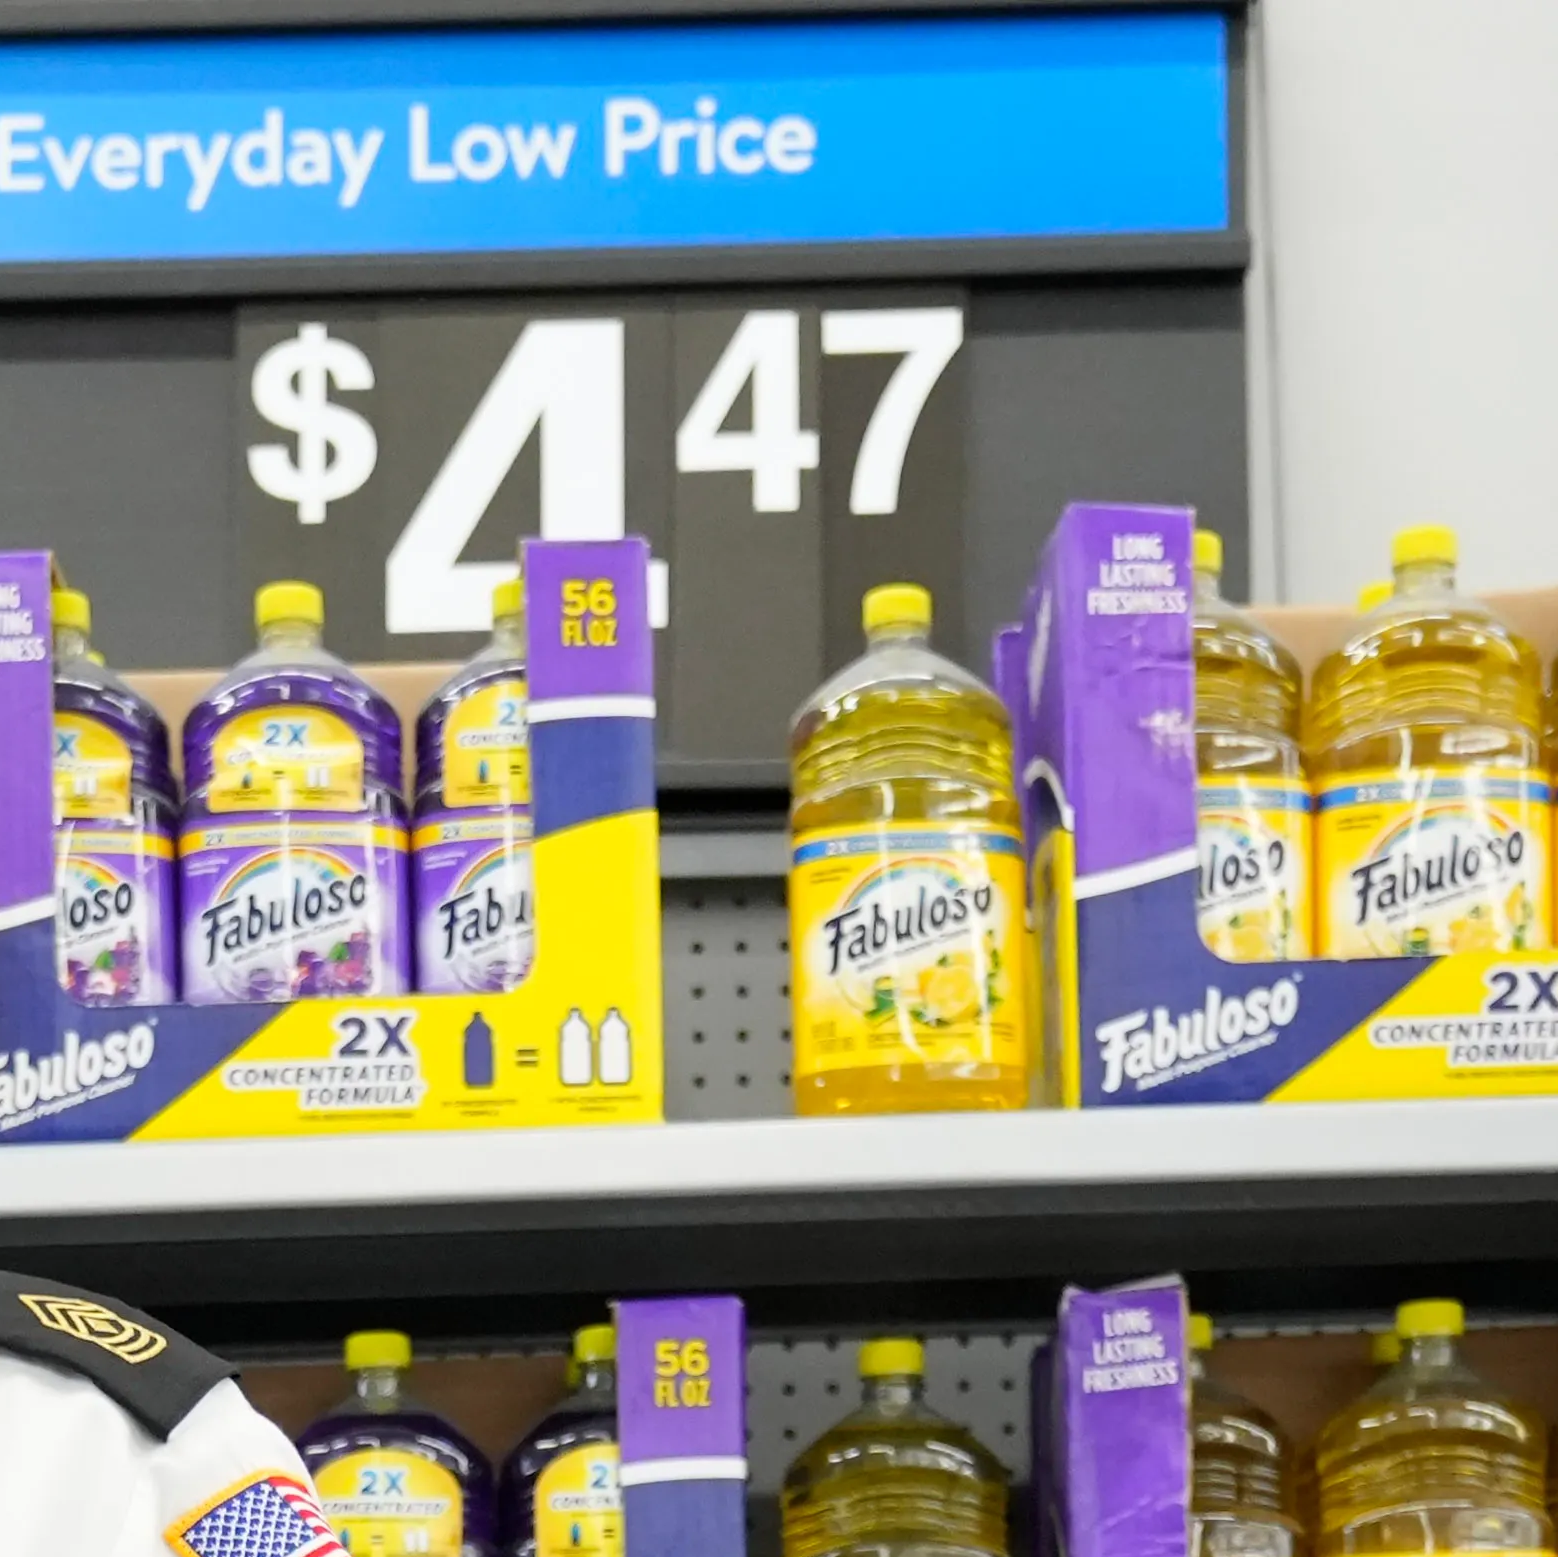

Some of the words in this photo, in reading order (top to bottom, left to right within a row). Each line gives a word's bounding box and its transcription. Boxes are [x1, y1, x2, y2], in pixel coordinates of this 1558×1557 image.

[409, 103, 576, 184] Low
[604, 97, 817, 178] Price
[1111, 534, 1164, 561] LONG
[1099, 561, 1176, 588] LASTING
[560, 578, 617, 617] 56
[1087, 589, 1187, 617] FRESHNESS
[561, 619, 592, 647] FL
[594, 619, 618, 647] OZ
[264, 722, 309, 748] 2X
[1350, 828, 1525, 926] Fabuloso
[202, 871, 368, 968] Fabuloso
[439, 876, 534, 962] Fabu
[823, 881, 994, 976] Fabuloso
[339, 1016, 412, 1057] 2X
[1096, 979, 1299, 1095] Fabuloso
[227, 1063, 417, 1087] CONCENTRATED
[306, 1084, 417, 1106] FORMULA
[1103, 1308, 1154, 1336] LONG
[654, 1339, 710, 1376] 56
[1092, 1336, 1166, 1364] LASTING
[1082, 1363, 1180, 1394] FRESHNESS
[654, 1379, 680, 1408] FL
[681, 1379, 711, 1407] OZ
[359, 1470, 404, 1496] 2X
